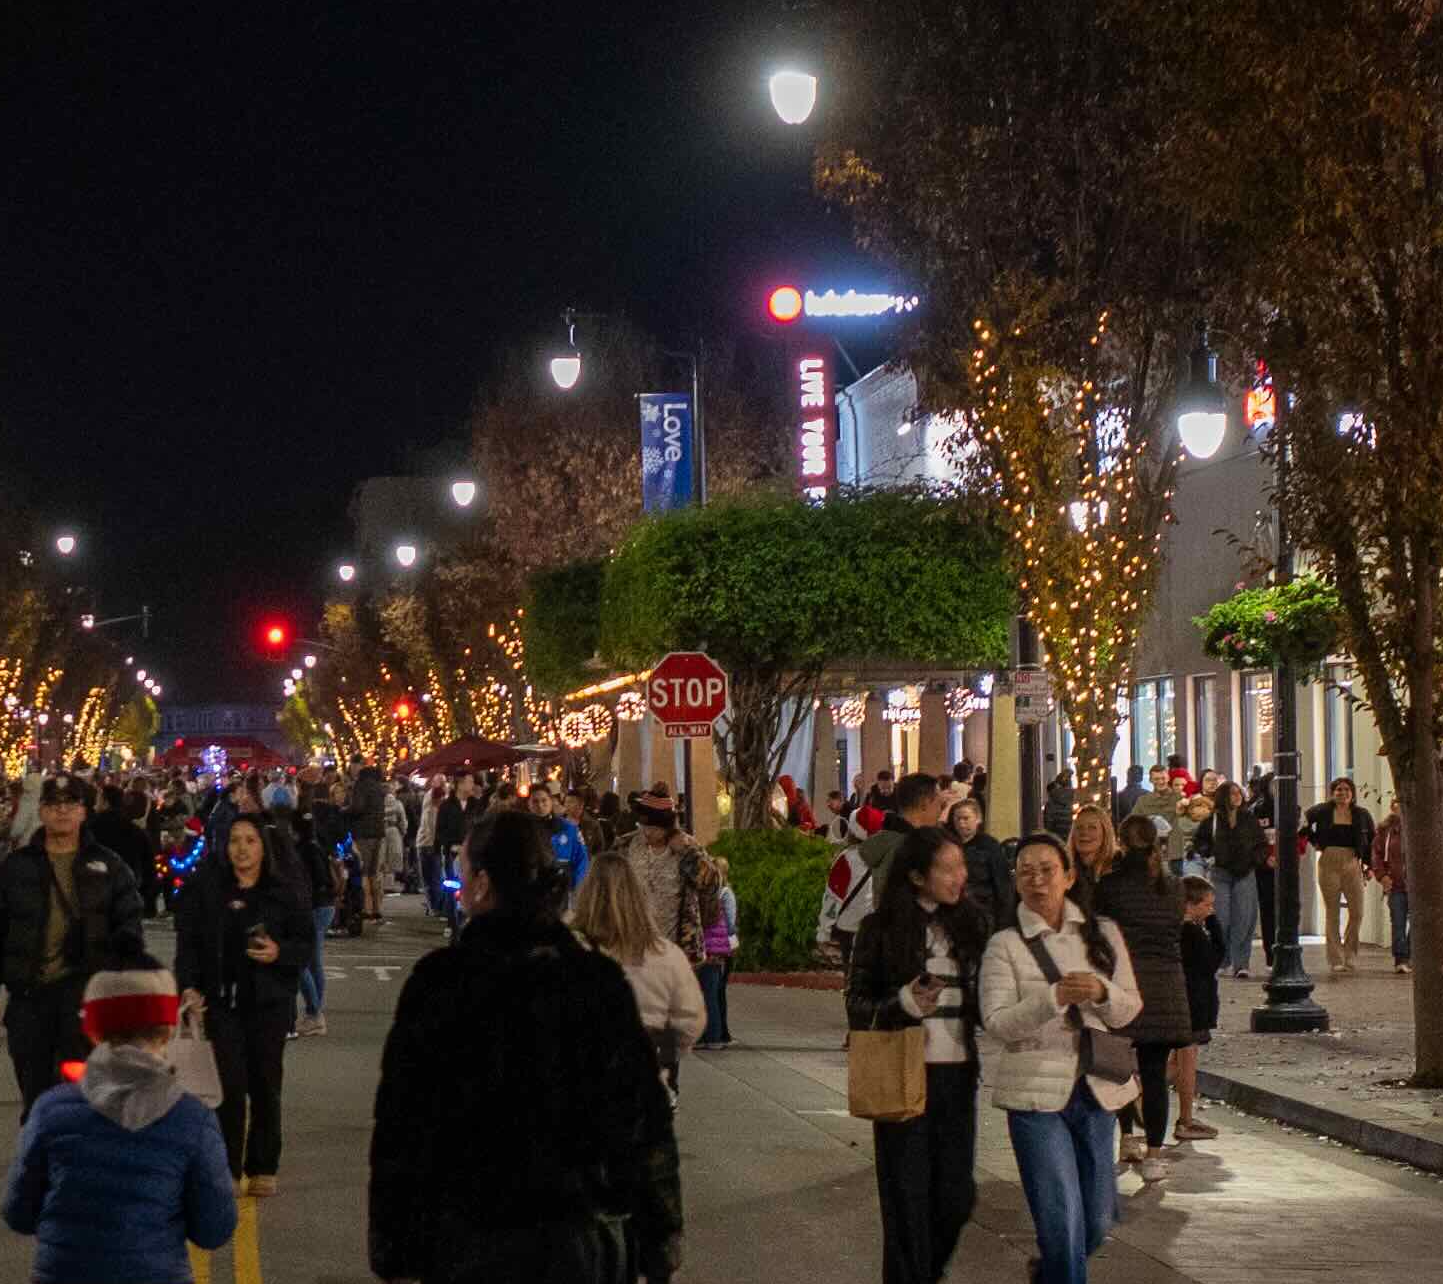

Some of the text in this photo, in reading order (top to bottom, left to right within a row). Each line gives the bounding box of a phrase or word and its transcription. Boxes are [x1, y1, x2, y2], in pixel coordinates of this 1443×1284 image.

[800, 359, 825, 408] LIVE
[663, 403, 689, 462] Love
[802, 418, 826, 475] YOUR
[652, 678, 723, 708] STOP
[668, 725, 709, 736] ALL WAY
